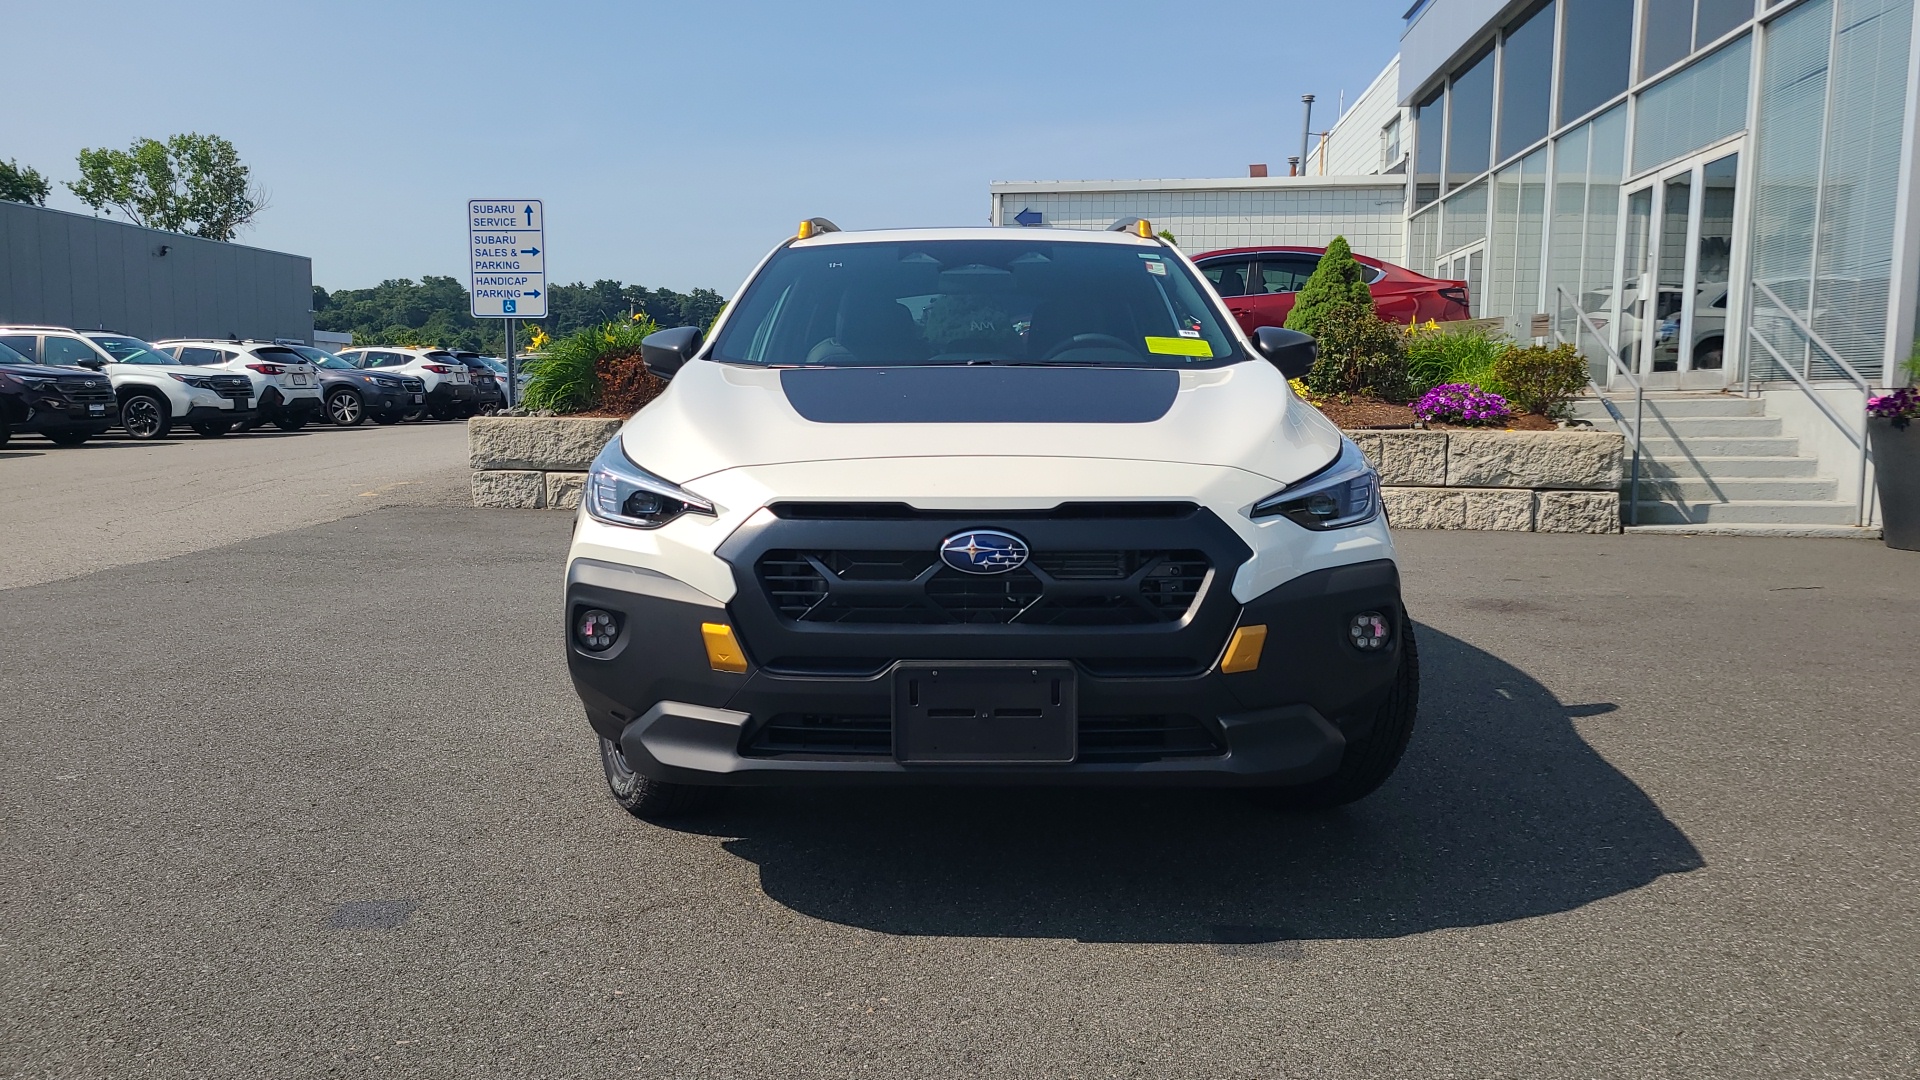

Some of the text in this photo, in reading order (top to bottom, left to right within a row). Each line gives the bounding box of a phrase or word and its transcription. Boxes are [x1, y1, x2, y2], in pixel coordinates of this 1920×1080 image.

[473, 205, 515, 214] SUBARU
[473, 218, 517, 226] SERVICE
[474, 236, 516, 244] SUBARU
[475, 249, 517, 257] SALES &
[475, 261, 520, 269] PARKING
[476, 277, 528, 286] HANDICAP
[476, 290, 521, 298] PARKING
